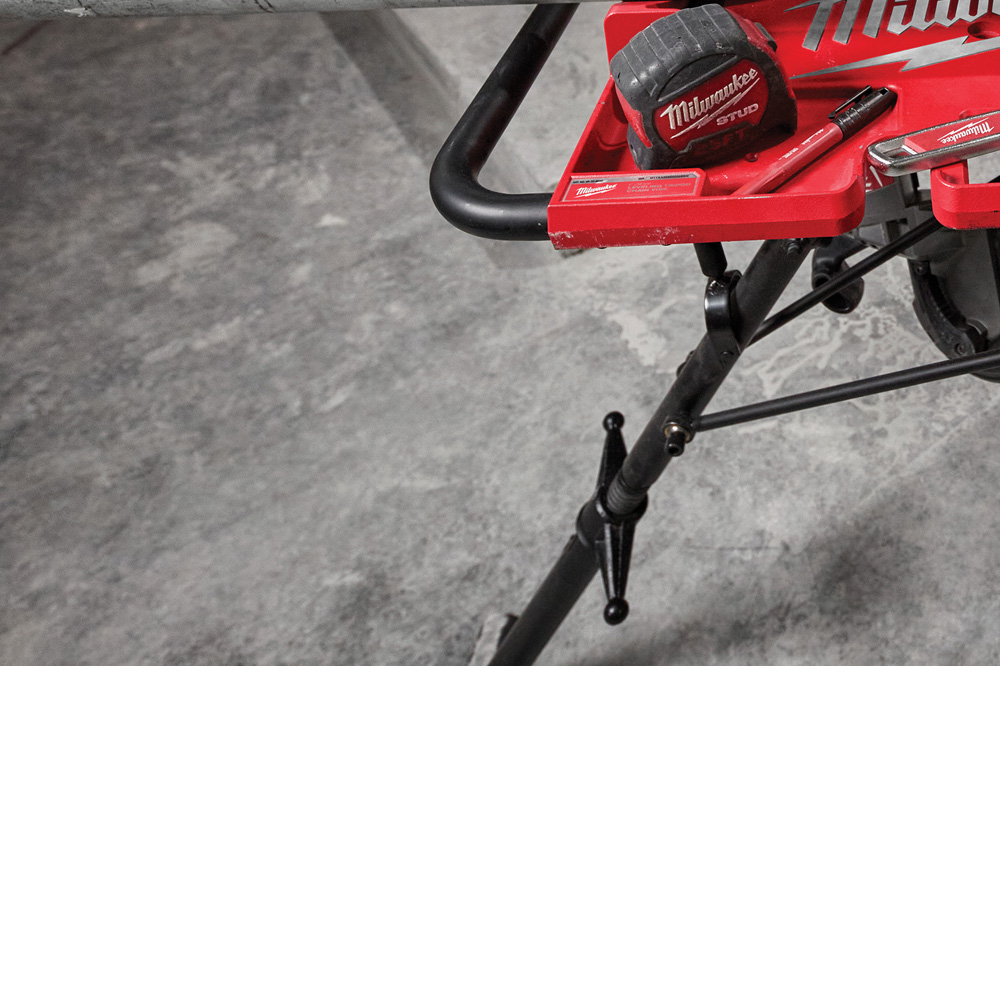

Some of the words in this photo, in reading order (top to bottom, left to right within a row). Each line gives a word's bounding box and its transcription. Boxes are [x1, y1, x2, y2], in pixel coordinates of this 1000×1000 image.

[660, 68, 758, 130] Milwaukee
[716, 103, 759, 126] STUD
[940, 121, 995, 144] Milwaukee
[575, 183, 618, 196] Milwaukee
